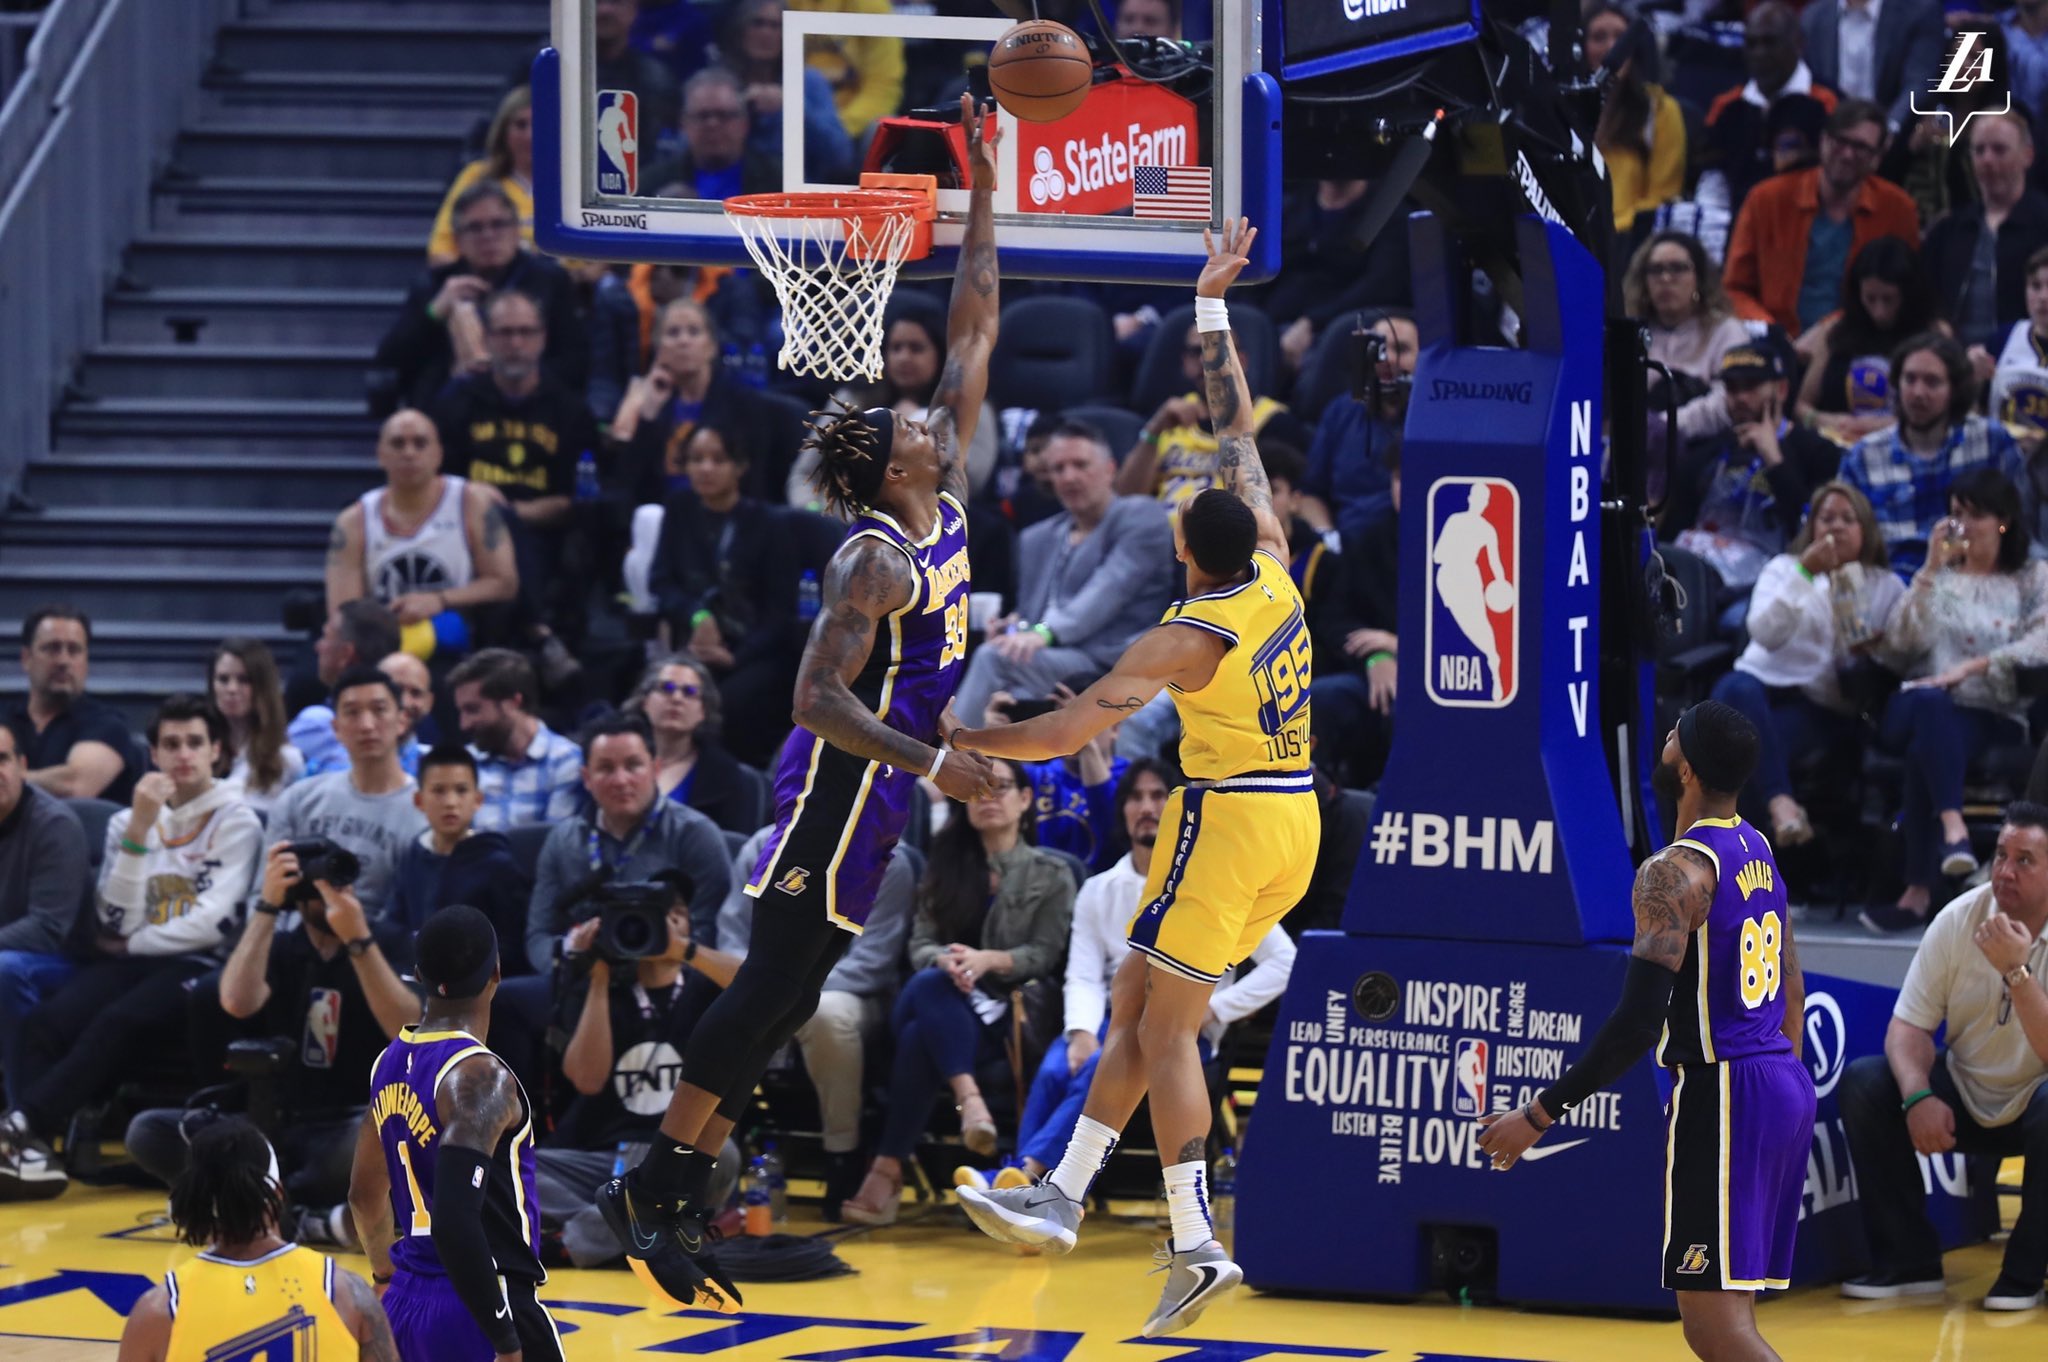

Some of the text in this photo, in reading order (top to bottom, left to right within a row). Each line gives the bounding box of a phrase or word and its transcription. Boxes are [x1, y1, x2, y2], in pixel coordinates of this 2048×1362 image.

[601, 172, 622, 190] NBA
[1516, 149, 1574, 235] SPALD
[581, 211, 648, 230] SPALDING
[1429, 378, 1532, 405] SPALDING
[944, 516, 963, 536] wish
[1568, 399, 1592, 738] NBA TV
[1439, 654, 1483, 691] NBA
[1370, 811, 1554, 874] #BHM
[1735, 859, 1774, 901] MORRIS
[1740, 910, 1782, 1010] 88
[1325, 990, 1347, 1043] UNIFY
[1405, 980, 1502, 1032] INSPIRE
[1507, 981, 1527, 1038] ENGAGE
[1527, 1009, 1582, 1043] DREAM
[1290, 1021, 1322, 1043] LEAD
[1349, 1027, 1450, 1054] PERSEVERANCE
[1285, 1045, 1451, 1112] EQUALITY
[1495, 1045, 1564, 1080] HISTORY
[1332, 1111, 1377, 1136] LISTEN
[1407, 1116, 1484, 1169] LOVE
[1378, 1114, 1404, 1184] BELIEVE
[397, 1140, 432, 1237] 1
